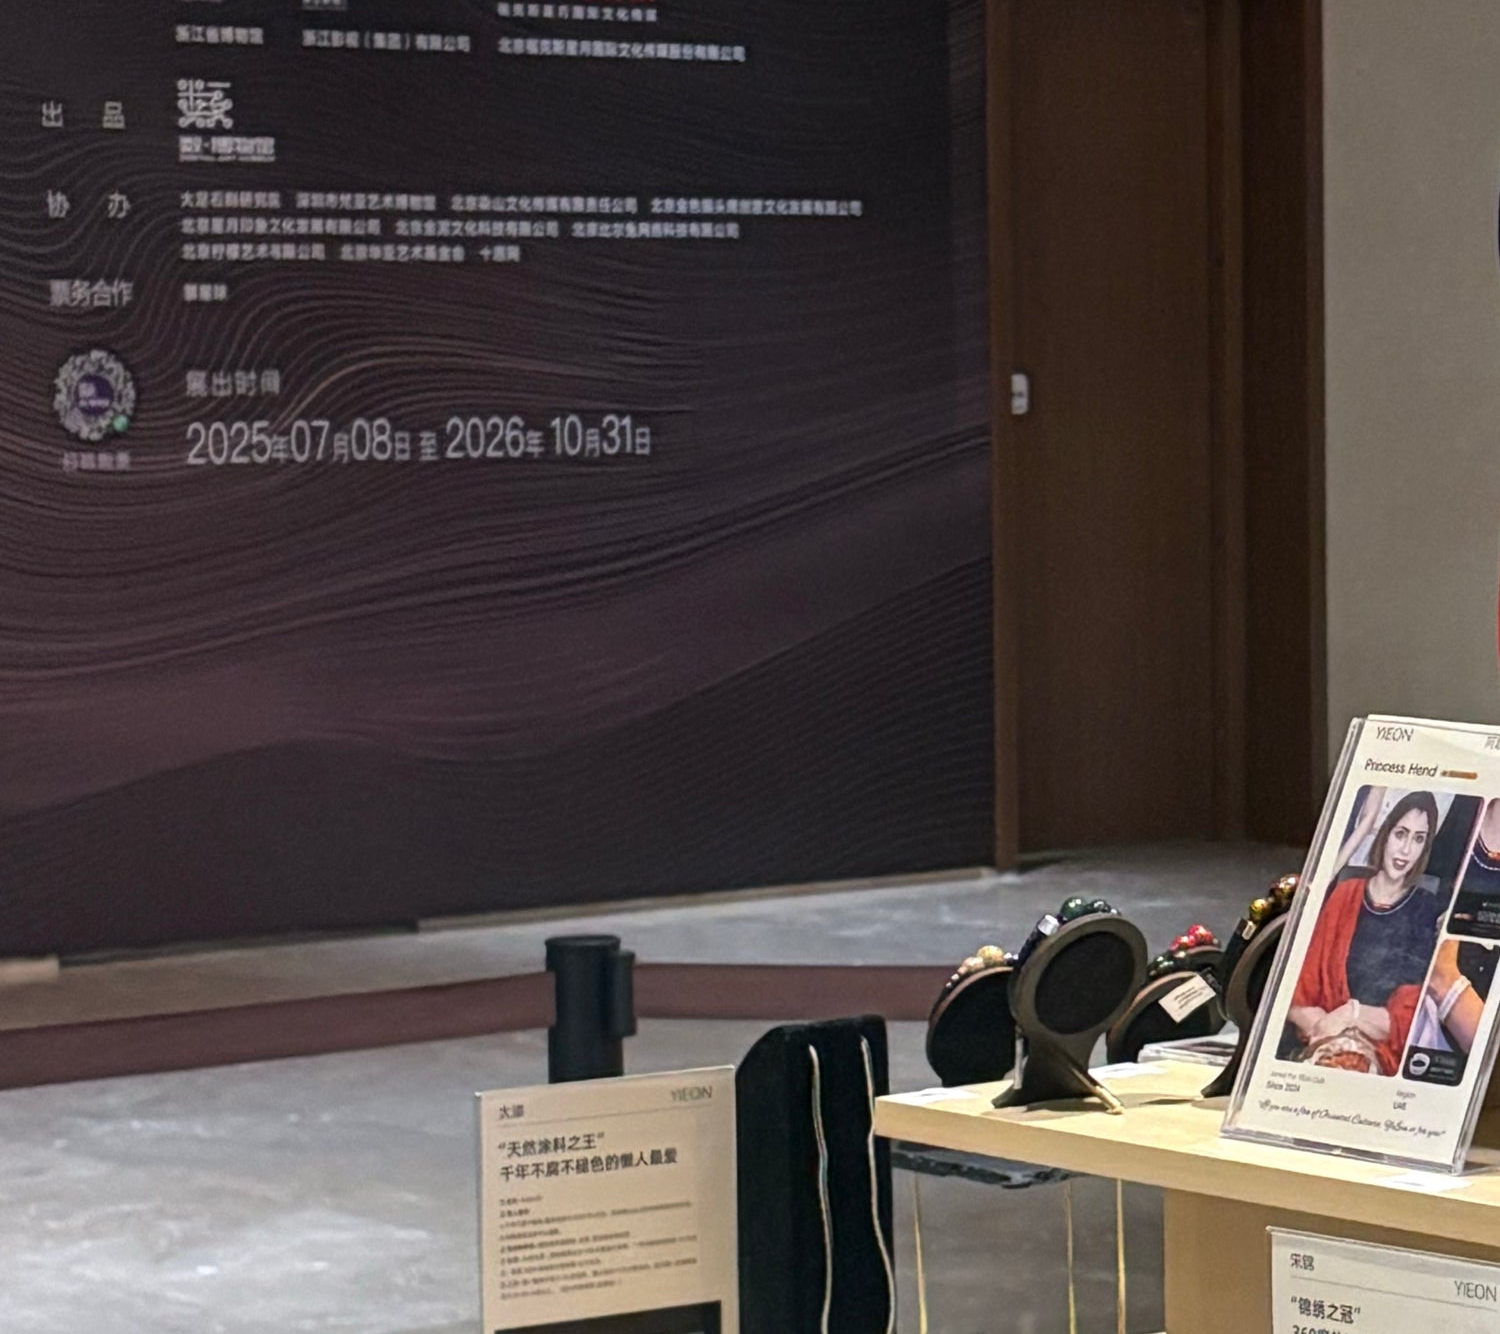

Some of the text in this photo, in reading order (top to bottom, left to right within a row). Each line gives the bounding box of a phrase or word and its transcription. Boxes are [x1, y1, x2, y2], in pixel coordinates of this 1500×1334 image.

[1376, 726, 1414, 742] YIEON
[671, 1086, 713, 1102] YIEON
[1454, 1280, 1498, 1303] YIEON
